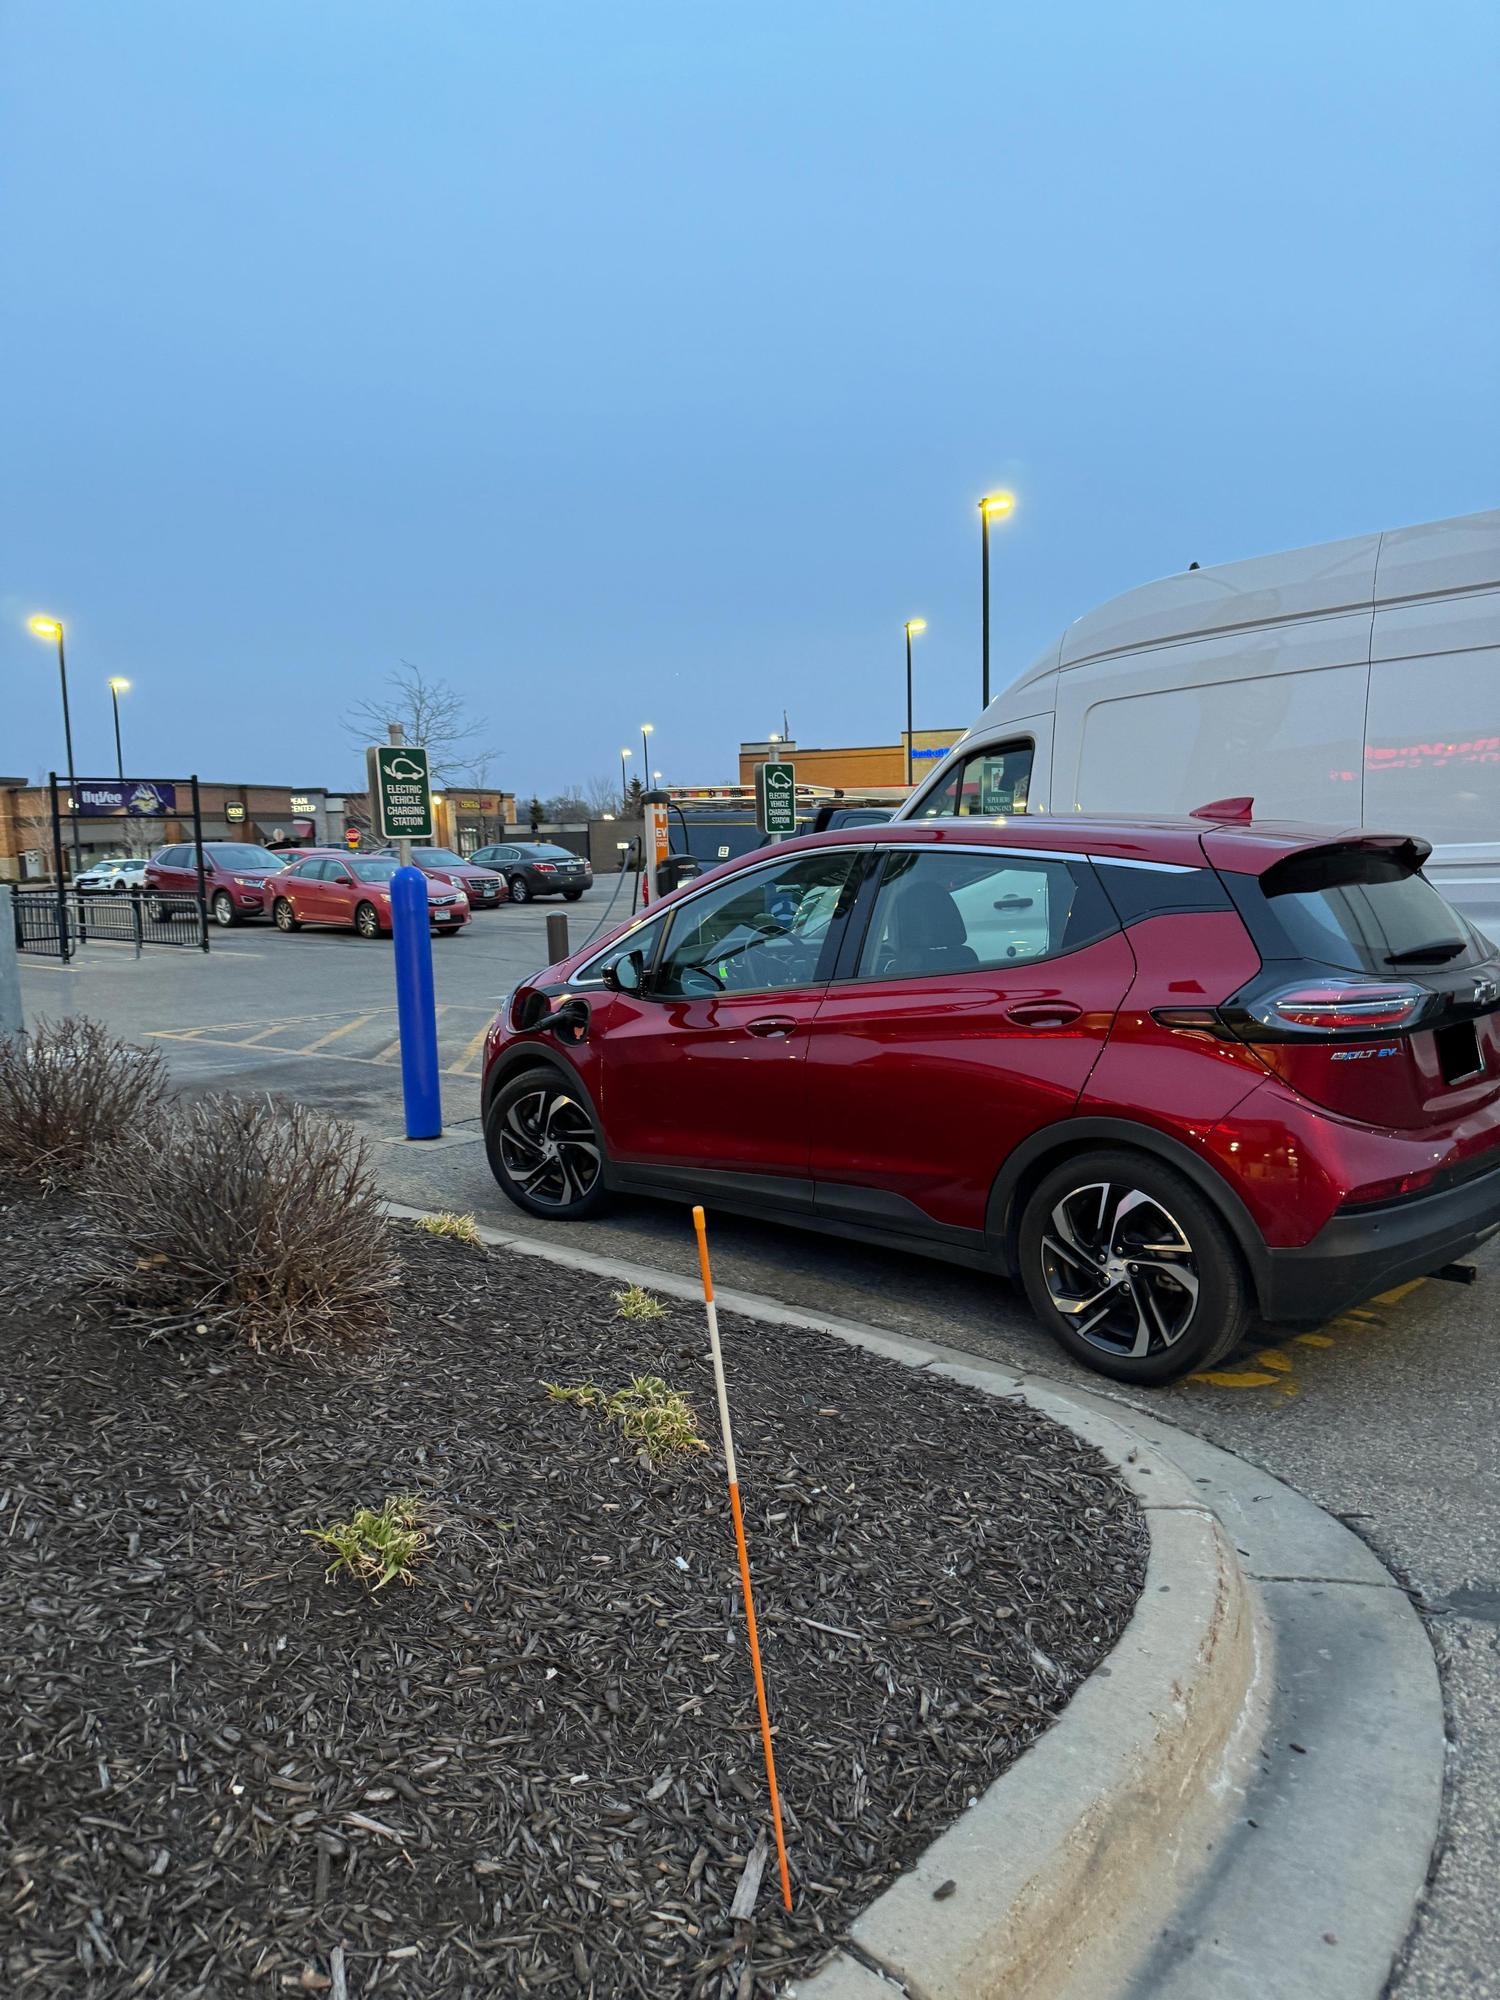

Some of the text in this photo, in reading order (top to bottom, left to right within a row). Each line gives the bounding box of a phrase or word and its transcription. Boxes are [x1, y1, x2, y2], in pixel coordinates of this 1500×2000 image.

[387, 785, 422, 794] ELECTRIC
[389, 795, 421, 804] VEHICLE
[770, 800, 789, 808] VEHICLE
[387, 806, 425, 815] CHARGING
[392, 817, 424, 826] STATION
[771, 816, 790, 824] STATION
[656, 828, 668, 838] EV
[1330, 1047, 1397, 1060] BOLT EV
